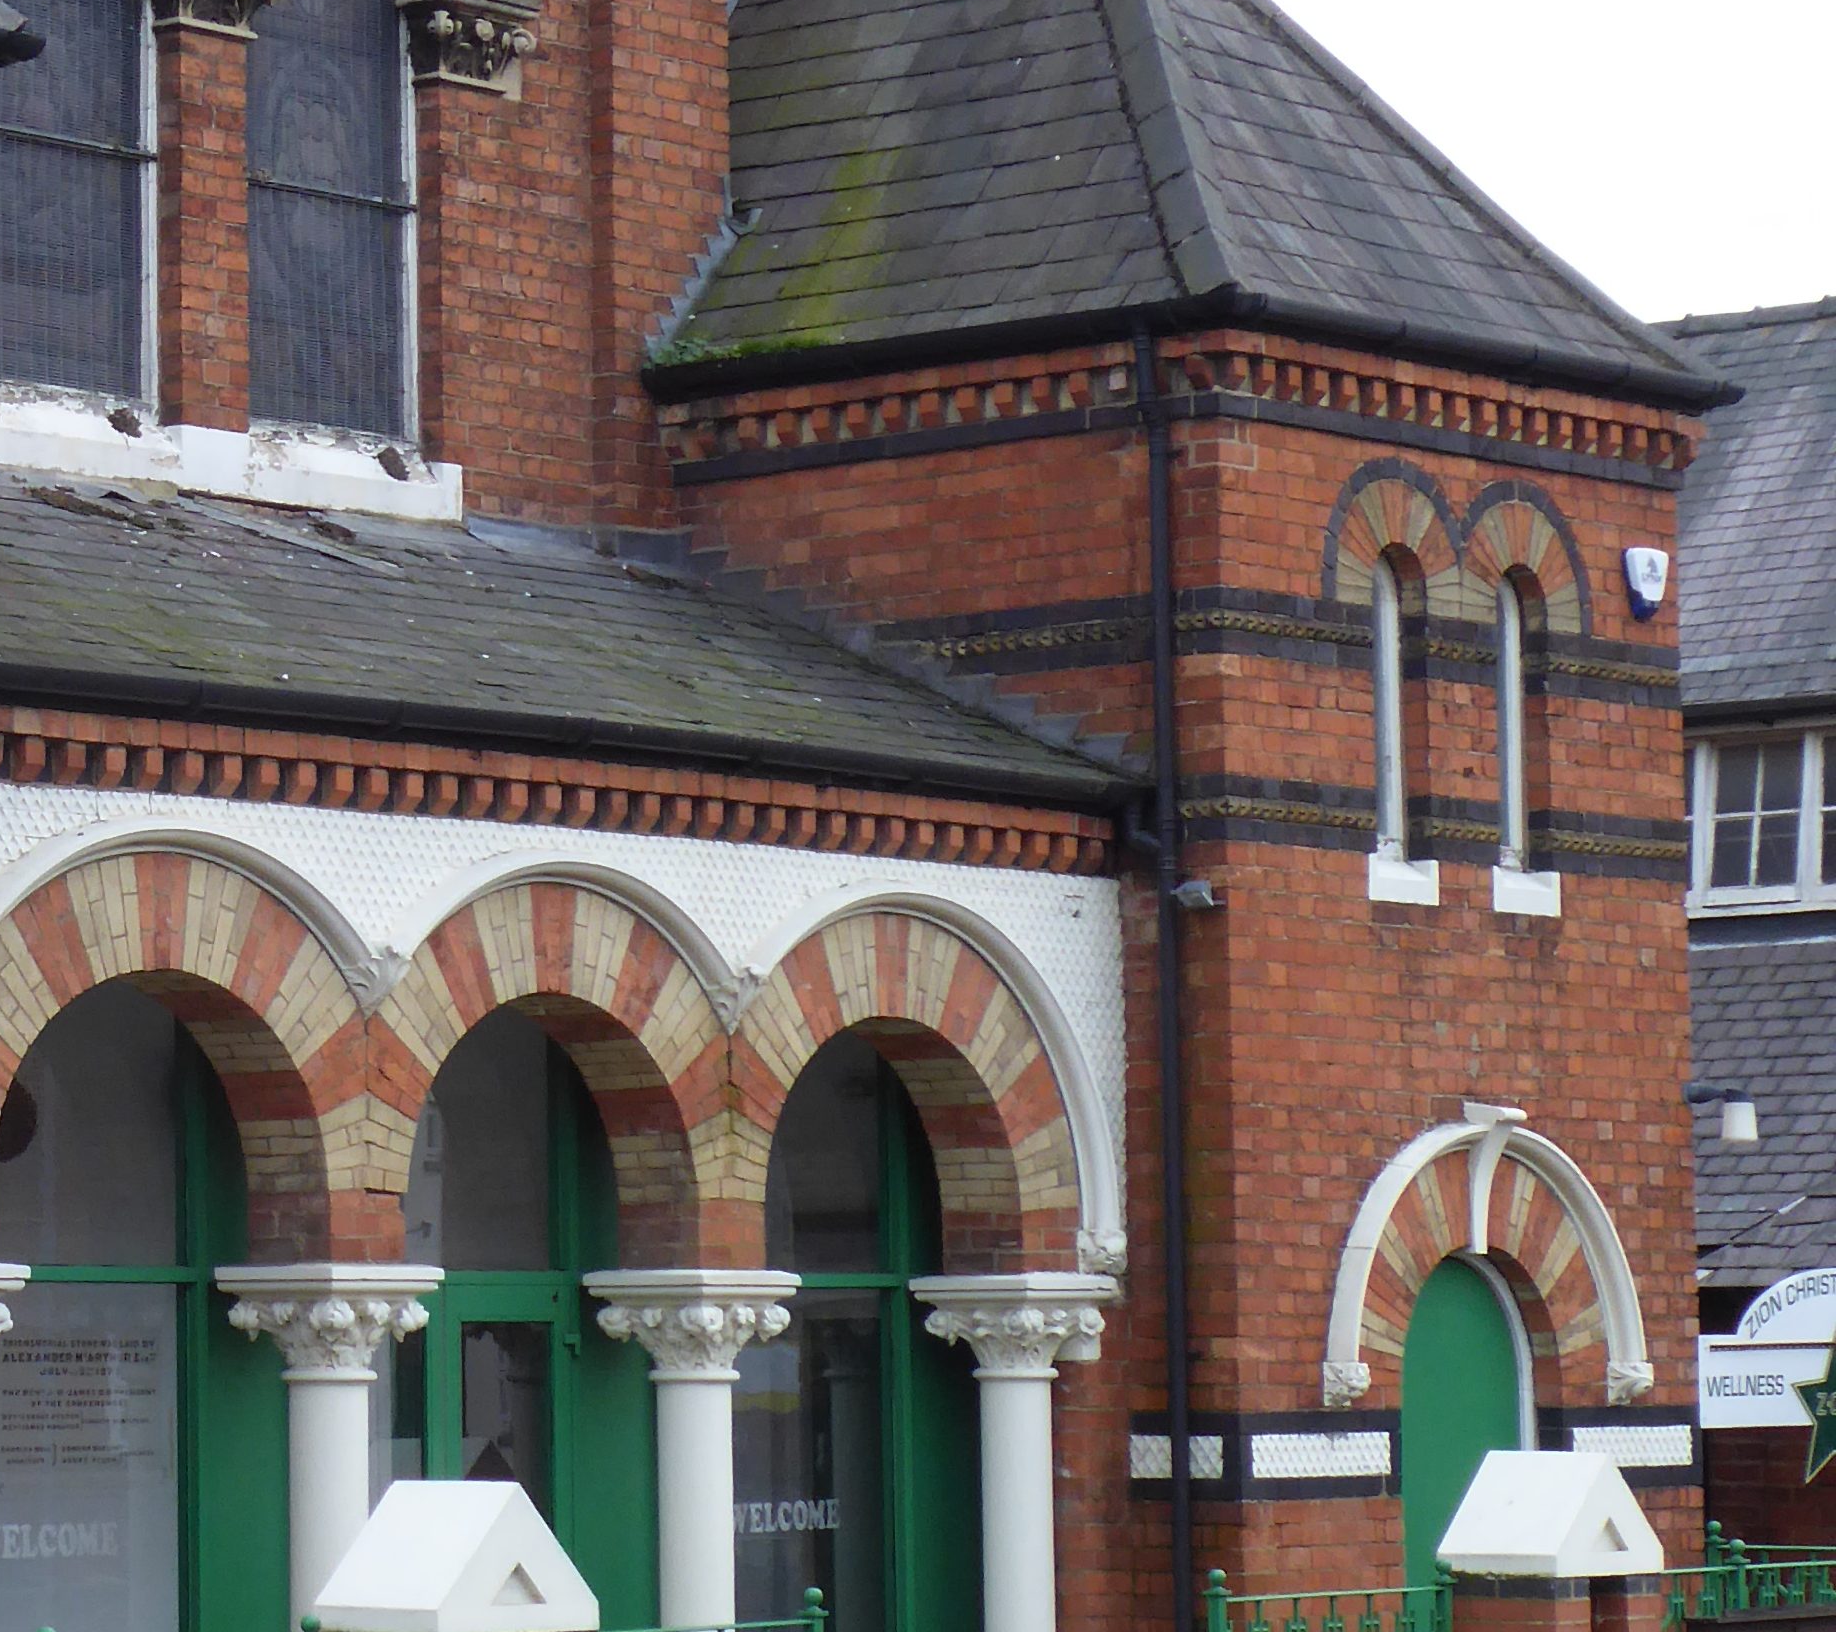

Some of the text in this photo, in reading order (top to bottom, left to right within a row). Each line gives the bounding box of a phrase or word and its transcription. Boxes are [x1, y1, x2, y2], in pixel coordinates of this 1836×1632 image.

[1745, 1290, 1782, 1340] ZION
[1707, 1374, 1784, 1397] WELLNESS
[733, 1498, 841, 1534] WELCOME
